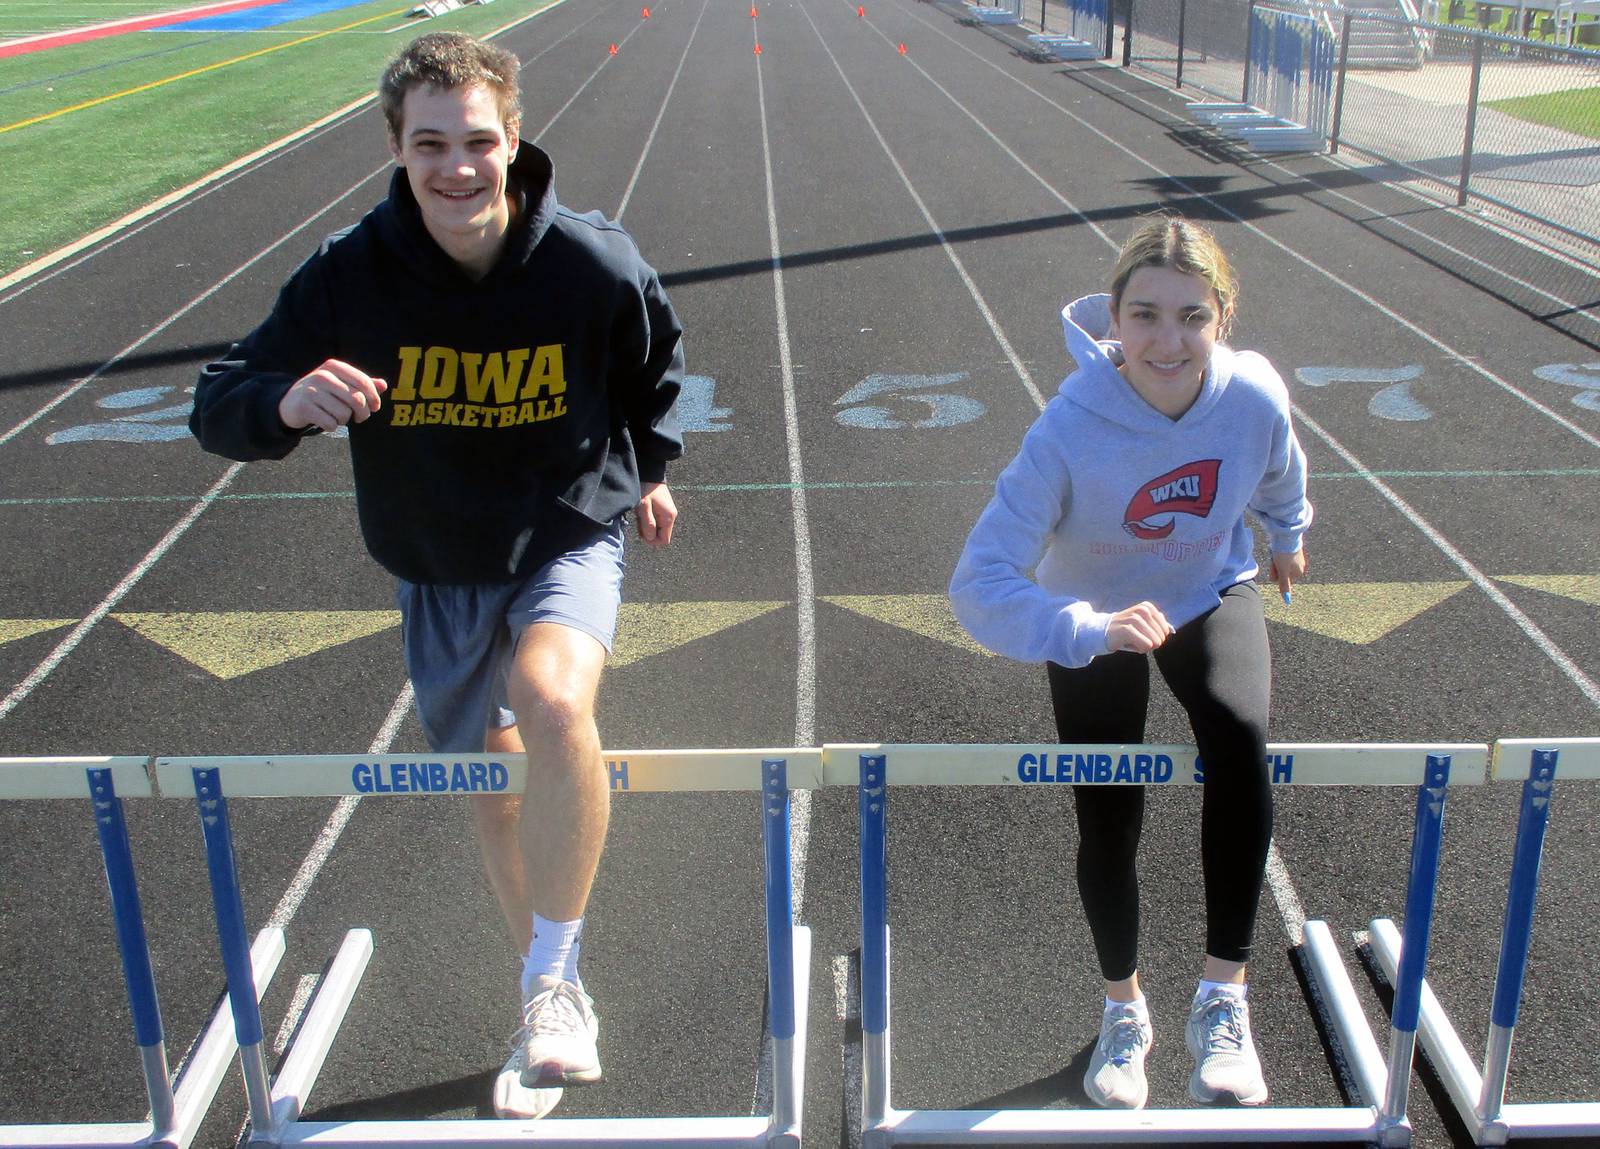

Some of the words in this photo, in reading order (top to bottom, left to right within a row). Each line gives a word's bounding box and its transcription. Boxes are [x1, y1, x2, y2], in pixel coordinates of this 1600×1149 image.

[391, 344, 567, 404] IOWA
[832, 371, 988, 429] 5
[1294, 363, 1435, 422] 7
[391, 396, 567, 428] BASKETBALL
[1149, 475, 1200, 504] WKU
[352, 762, 509, 793] GLENBARD
[1017, 753, 1173, 783] GLENBARD
